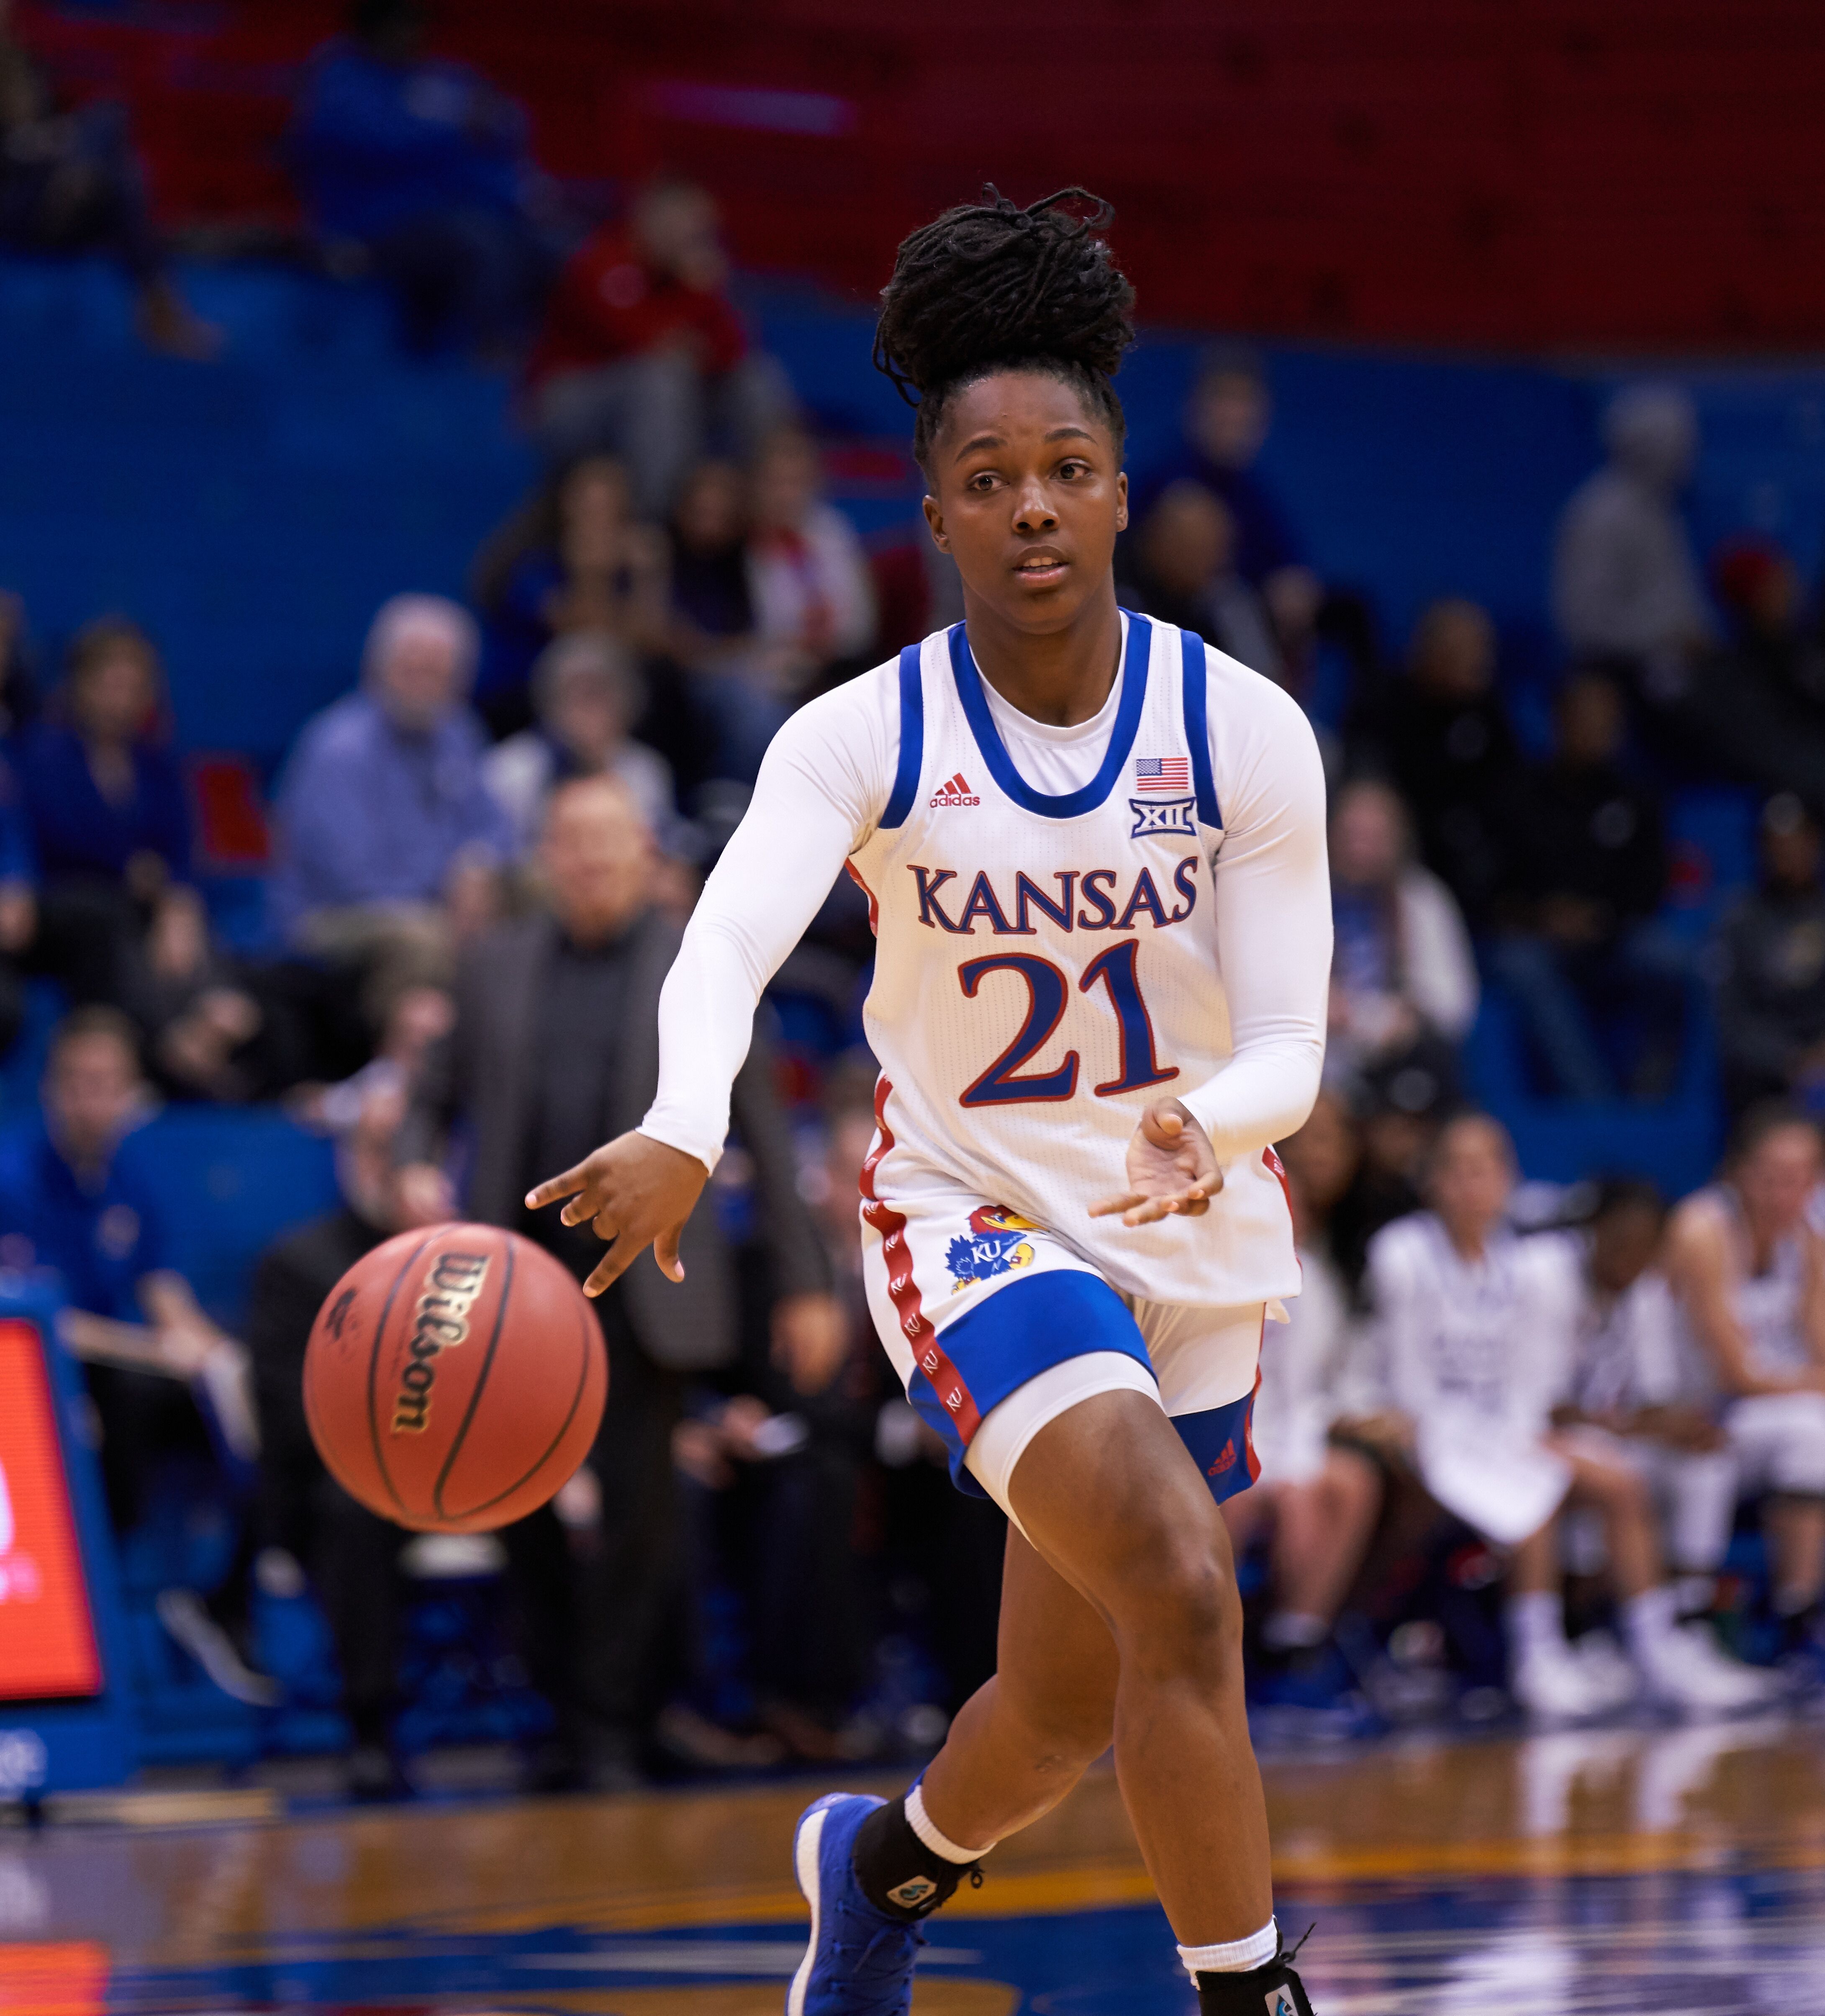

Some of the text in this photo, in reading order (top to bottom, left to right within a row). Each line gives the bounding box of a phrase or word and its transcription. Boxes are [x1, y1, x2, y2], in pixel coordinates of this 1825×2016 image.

[930, 794, 980, 808] adidas
[907, 856, 1198, 935] KANSAS
[957, 938, 1180, 1108] 21
[970, 1239, 1001, 1264] KU
[904, 1313, 921, 1337] KU
[392, 1253, 492, 1433] Wilson
[922, 1350, 938, 1375] KU
[946, 1386, 963, 1412] KU
